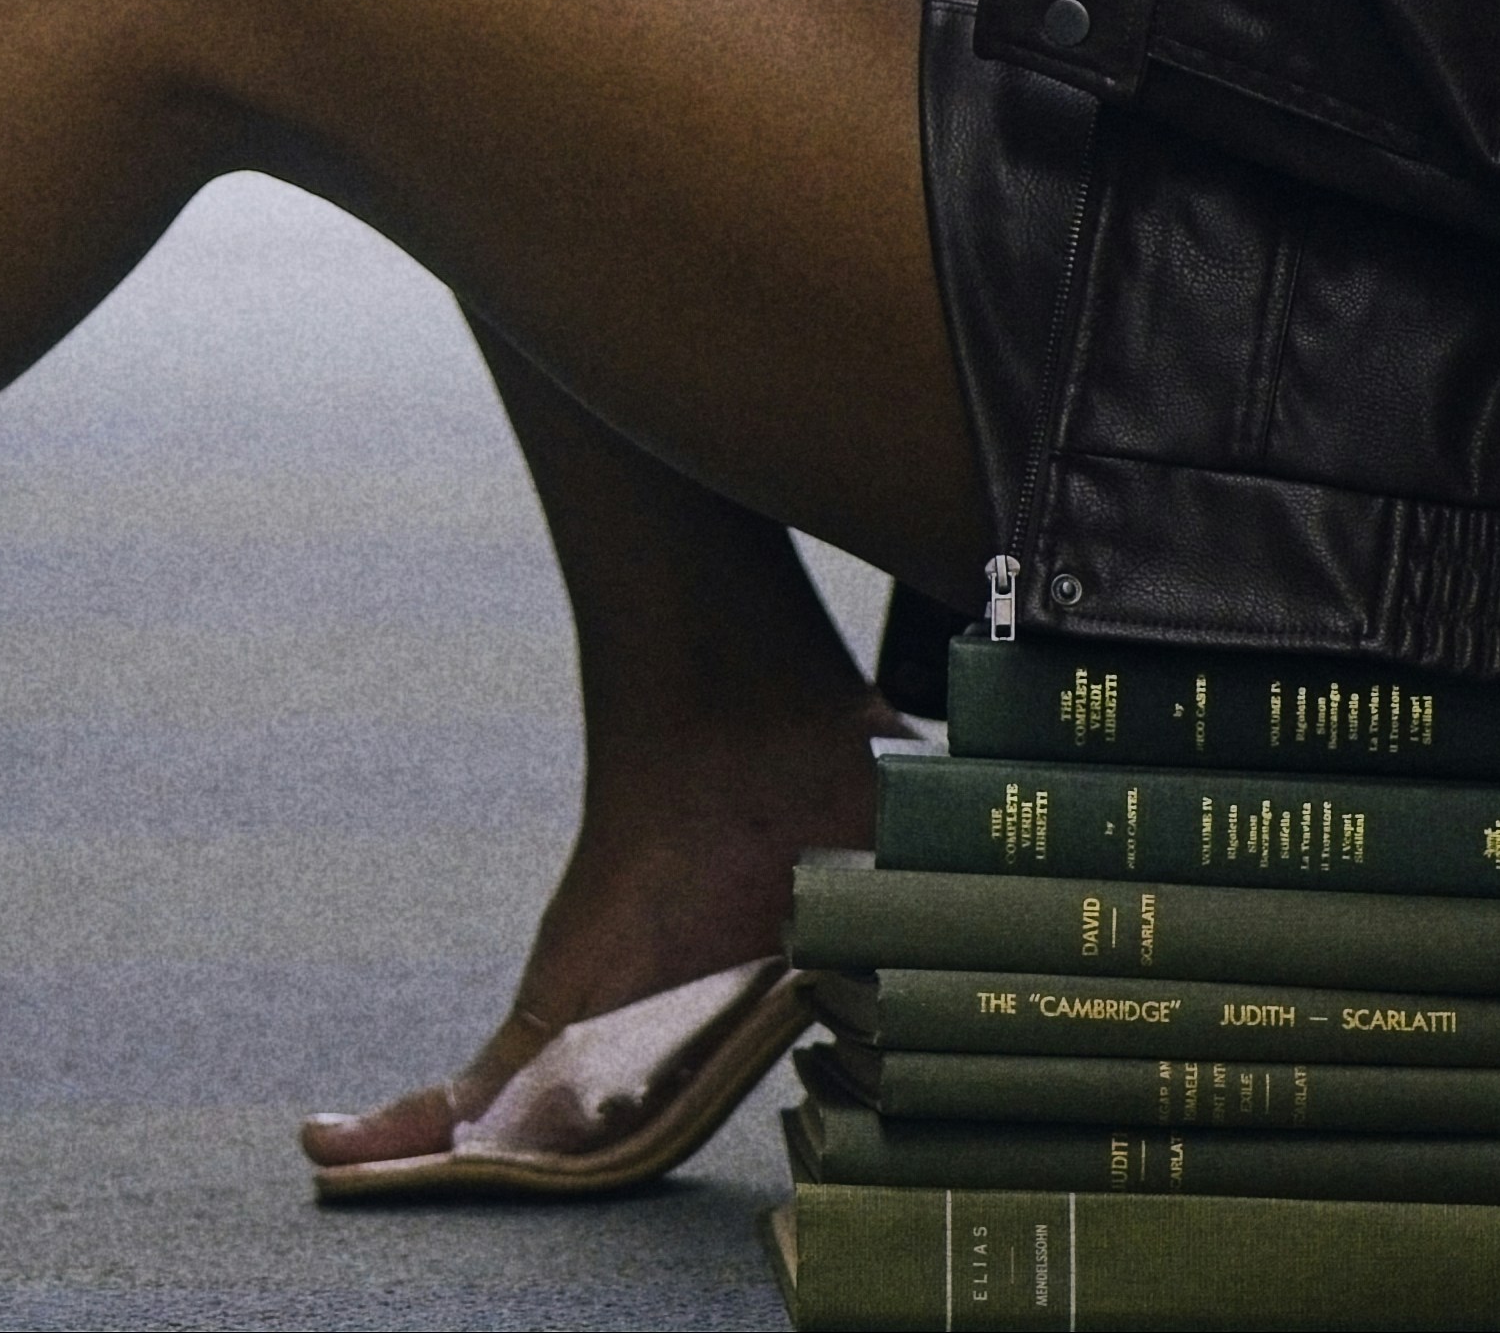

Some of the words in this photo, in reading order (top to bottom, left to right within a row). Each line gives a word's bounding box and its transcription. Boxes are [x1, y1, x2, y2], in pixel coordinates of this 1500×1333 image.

[1060, 689, 1073, 722] THE
[1090, 683, 1102, 730] VERDI
[1104, 673, 1118, 742] LIBRETTI
[1270, 695, 1281, 748] VOLUME
[1295, 686, 1308, 742] Rigoletto
[1316, 696, 1326, 736] Simon
[1409, 695, 1423, 734] Vespri
[1422, 694, 1433, 746] Siciliani
[1368, 737, 1379, 752] La
[991, 808, 1003, 840] THE
[1005, 782, 1019, 865] COMPLETE
[1020, 800, 1033, 849] VERDI
[1035, 790, 1048, 860] LIBRETTI
[1104, 821, 1116, 836] by
[1126, 786, 1138, 837] CASTEL
[1201, 796, 1213, 811] IV
[1300, 802, 1312, 852] Traviata
[1126, 838, 1137, 870] NICO
[1201, 812, 1212, 866] VOLUME
[1227, 803, 1240, 860] Rigoletto
[1247, 814, 1258, 854] Simon
[1260, 799, 1273, 869] Boccanegra
[1321, 800, 1332, 860] Trovatore
[1341, 813, 1355, 852] Vespri
[1354, 813, 1365, 864] Siciliani
[1300, 855, 1310, 870] La
[1082, 897, 1100, 957] DAVID
[1140, 893, 1156, 967] SCARLATTI
[977, 992, 1017, 1015] THE
[1029, 992, 1182, 1024] "CAMBRIDGE"
[1220, 1004, 1295, 1028] JUDITH
[1341, 1008, 1457, 1034] SCARLATTI
[1184, 1061, 1198, 1122] ISMAELE
[1213, 1061, 1226, 1089] INT
[1240, 1072, 1254, 1113] EXILE
[972, 1226, 988, 1301] ELIAS
[1035, 1224, 1048, 1307] MENDELSSOHN
